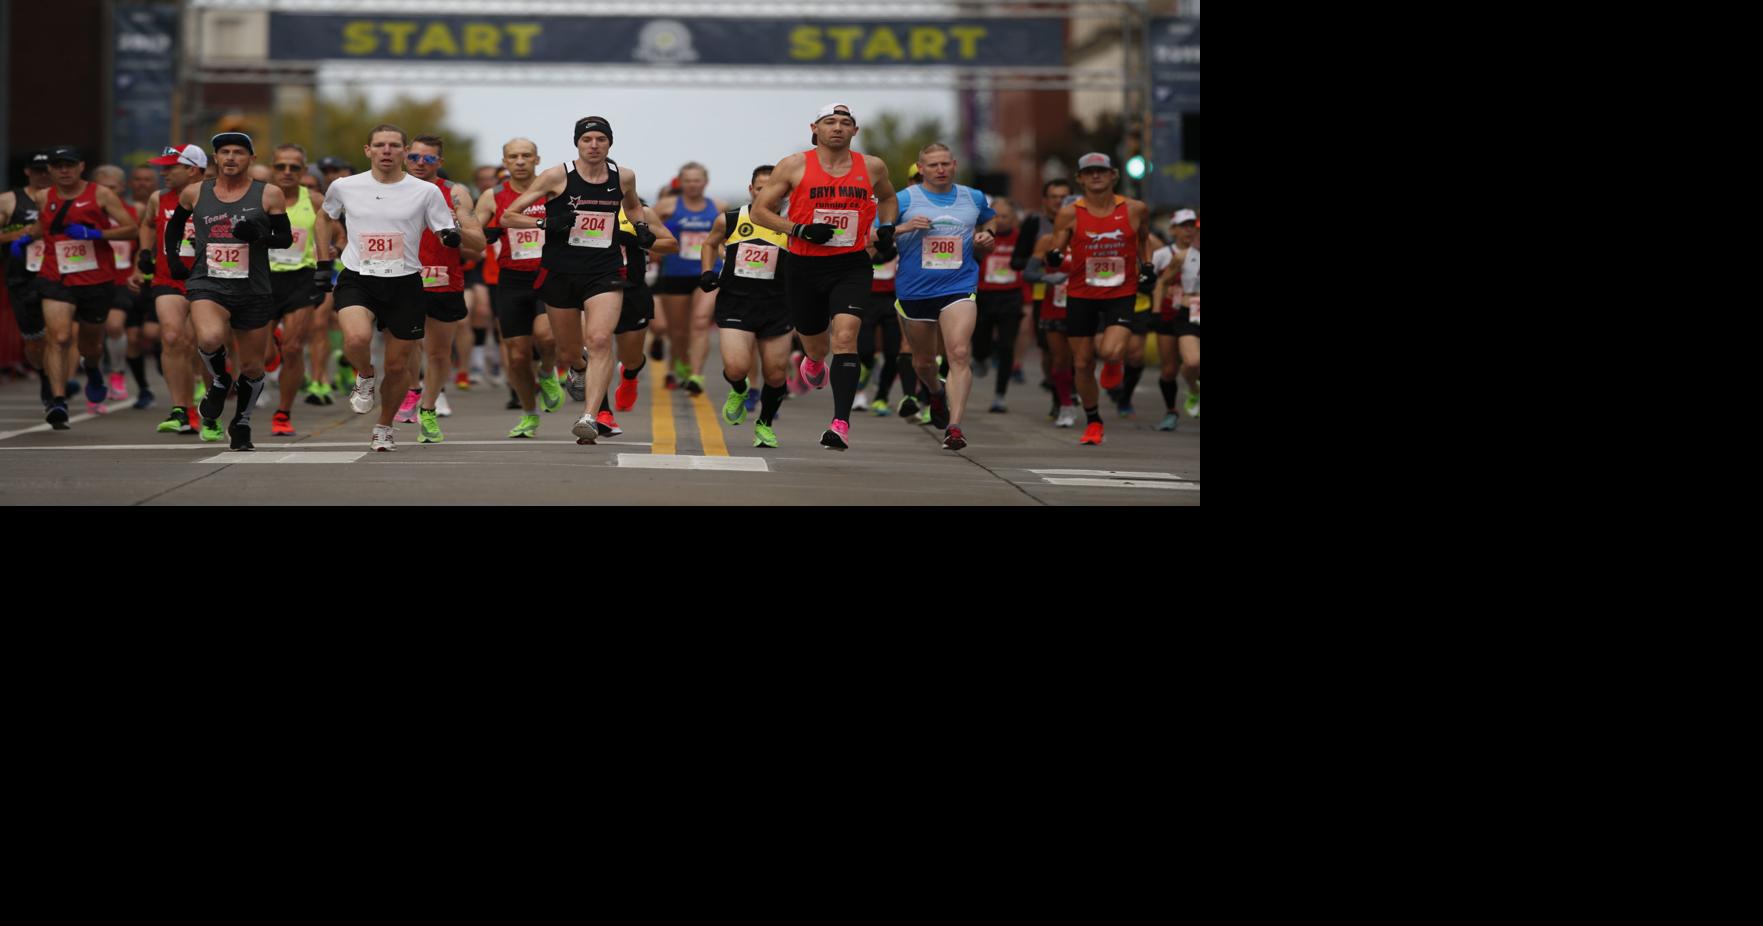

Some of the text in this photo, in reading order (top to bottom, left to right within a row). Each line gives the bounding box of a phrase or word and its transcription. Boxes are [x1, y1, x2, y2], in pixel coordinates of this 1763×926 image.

[342, 21, 541, 56] START
[790, 26, 986, 60] START
[203, 212, 228, 225] Team
[581, 217, 606, 231] 204
[823, 215, 849, 230] 250
[516, 230, 540, 244] 267
[64, 244, 87, 258] 228
[368, 238, 393, 252] 281
[931, 241, 955, 254] 208
[214, 249, 240, 263] 212
[744, 249, 769, 264] 224
[424, 266, 439, 278] 71
[1094, 262, 1116, 273] 231
